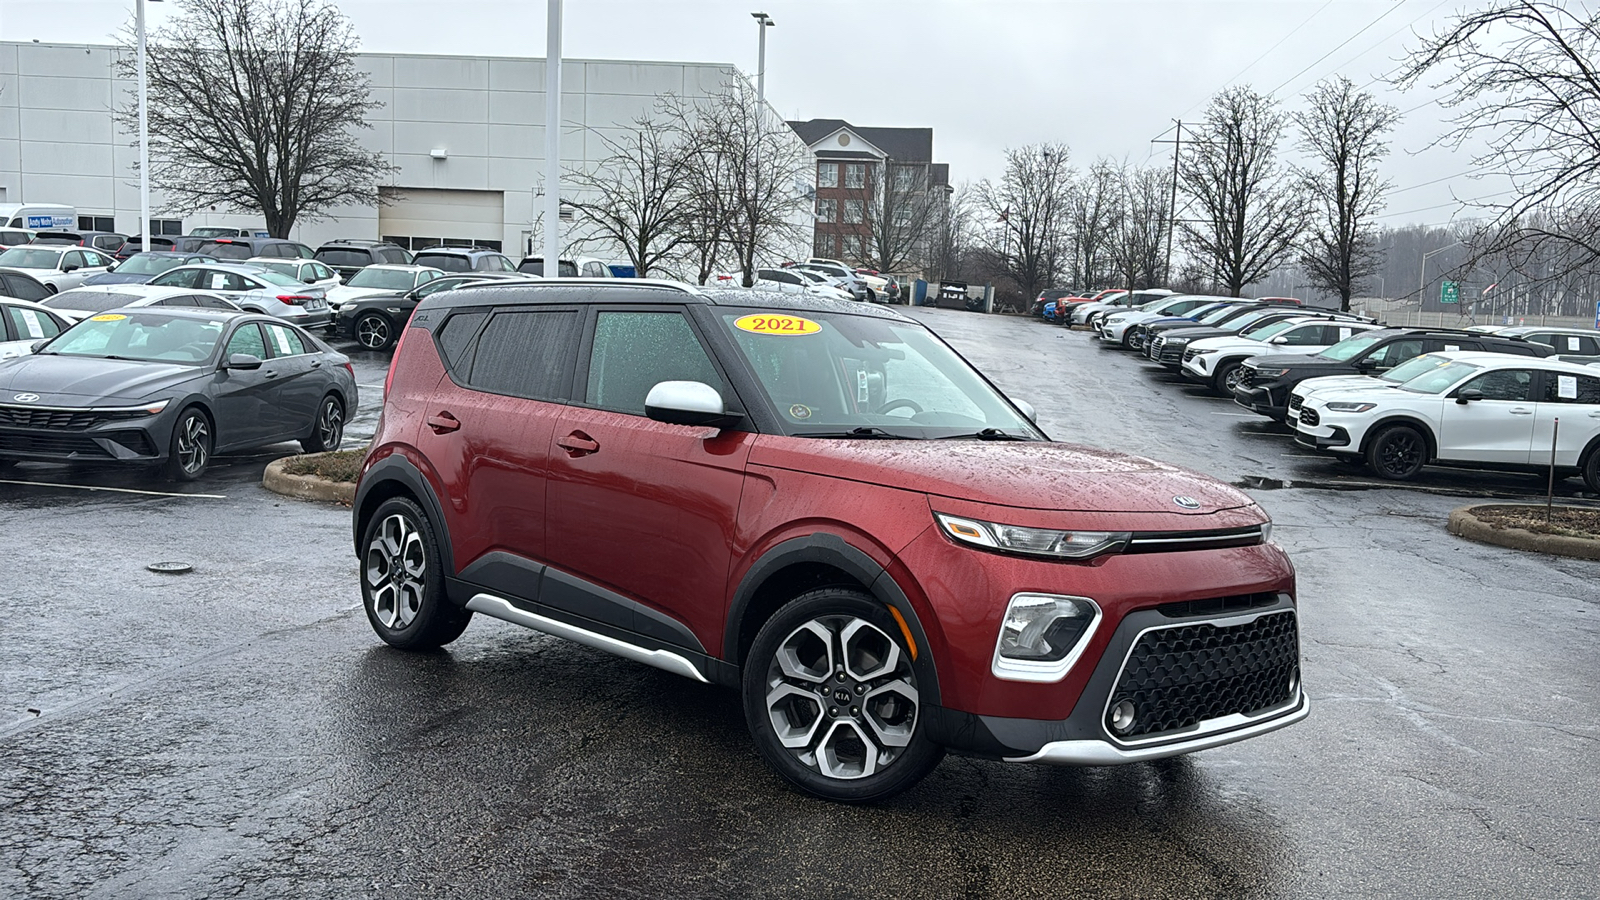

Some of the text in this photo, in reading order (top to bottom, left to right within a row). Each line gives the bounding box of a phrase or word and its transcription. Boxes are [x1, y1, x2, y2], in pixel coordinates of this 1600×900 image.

[29, 217, 40, 227] Andy
[40, 217, 52, 226] Mohr
[752, 318, 806, 331] 2021
[834, 692, 850, 702] KIA
